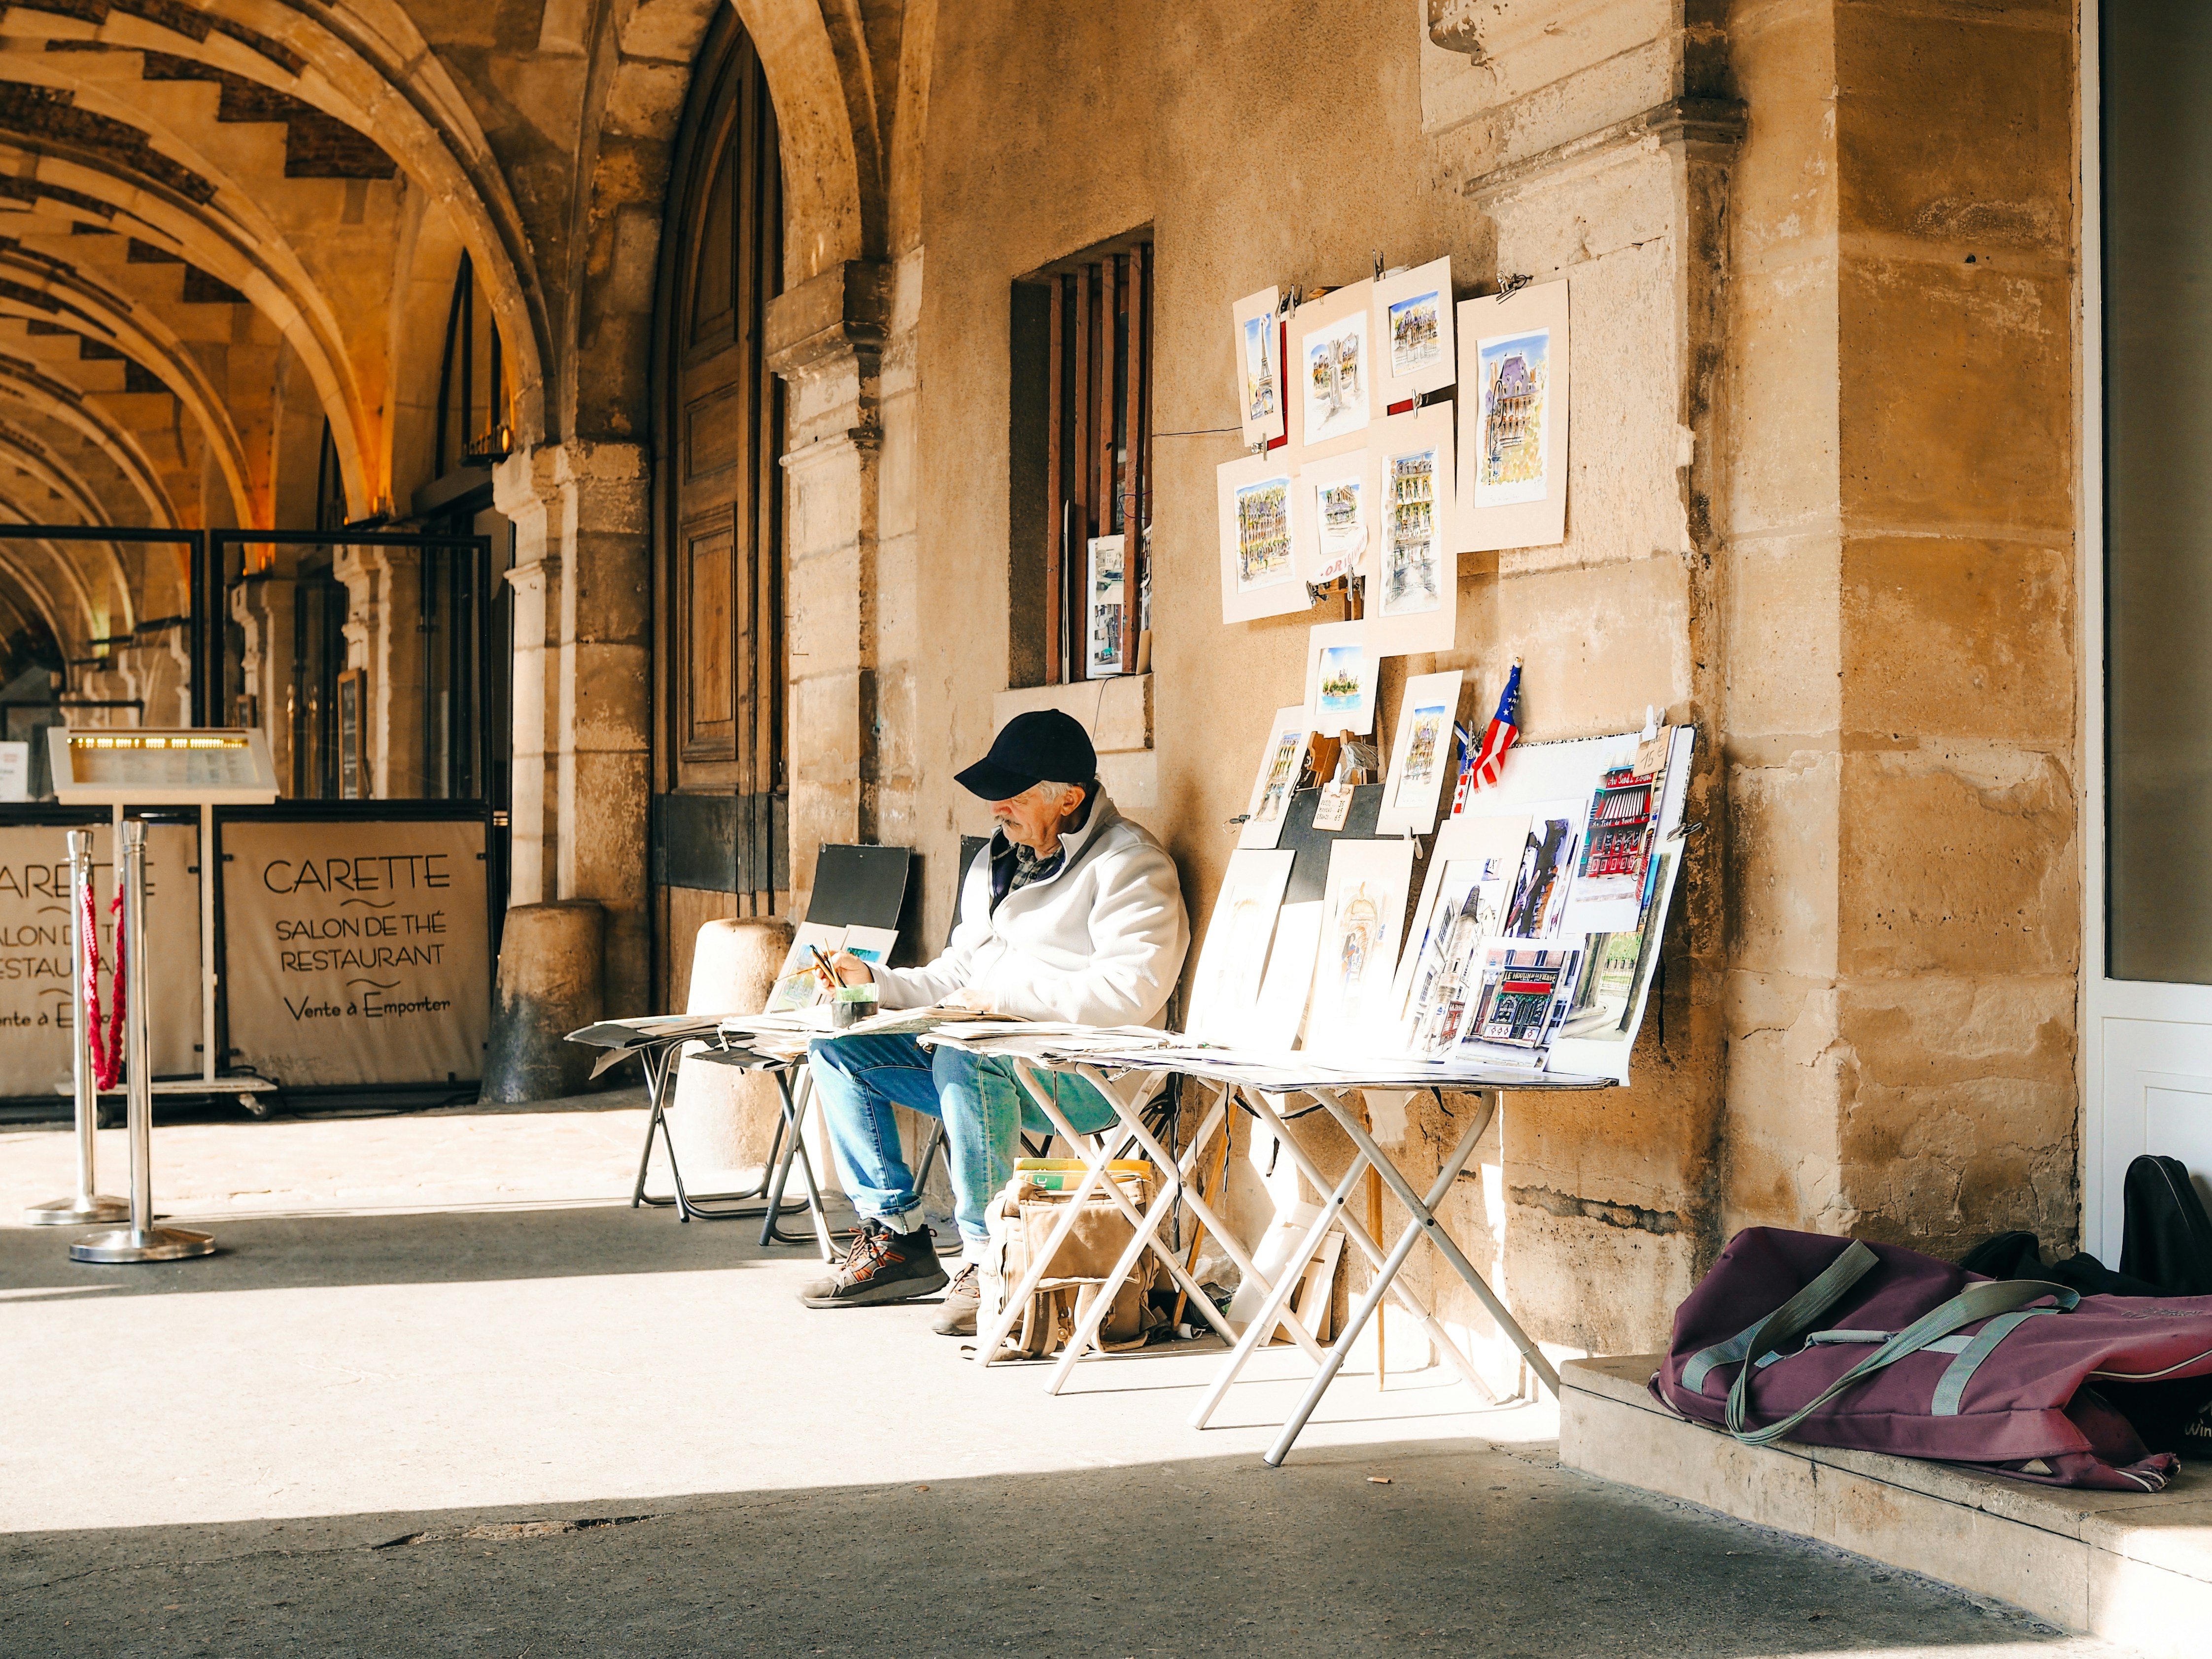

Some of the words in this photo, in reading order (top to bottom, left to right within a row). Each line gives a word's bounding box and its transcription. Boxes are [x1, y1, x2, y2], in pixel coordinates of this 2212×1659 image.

[1640, 750, 1655, 769] 15
[264, 854, 450, 894] CARETTE
[276, 917, 359, 941] SALON
[365, 915, 397, 936] DE
[401, 910, 447, 935] THÉ
[281, 944, 445, 972] RESTAURANT
[284, 995, 341, 1021] Vente
[346, 1002, 357, 1016] à
[363, 991, 450, 1017] Emporter
